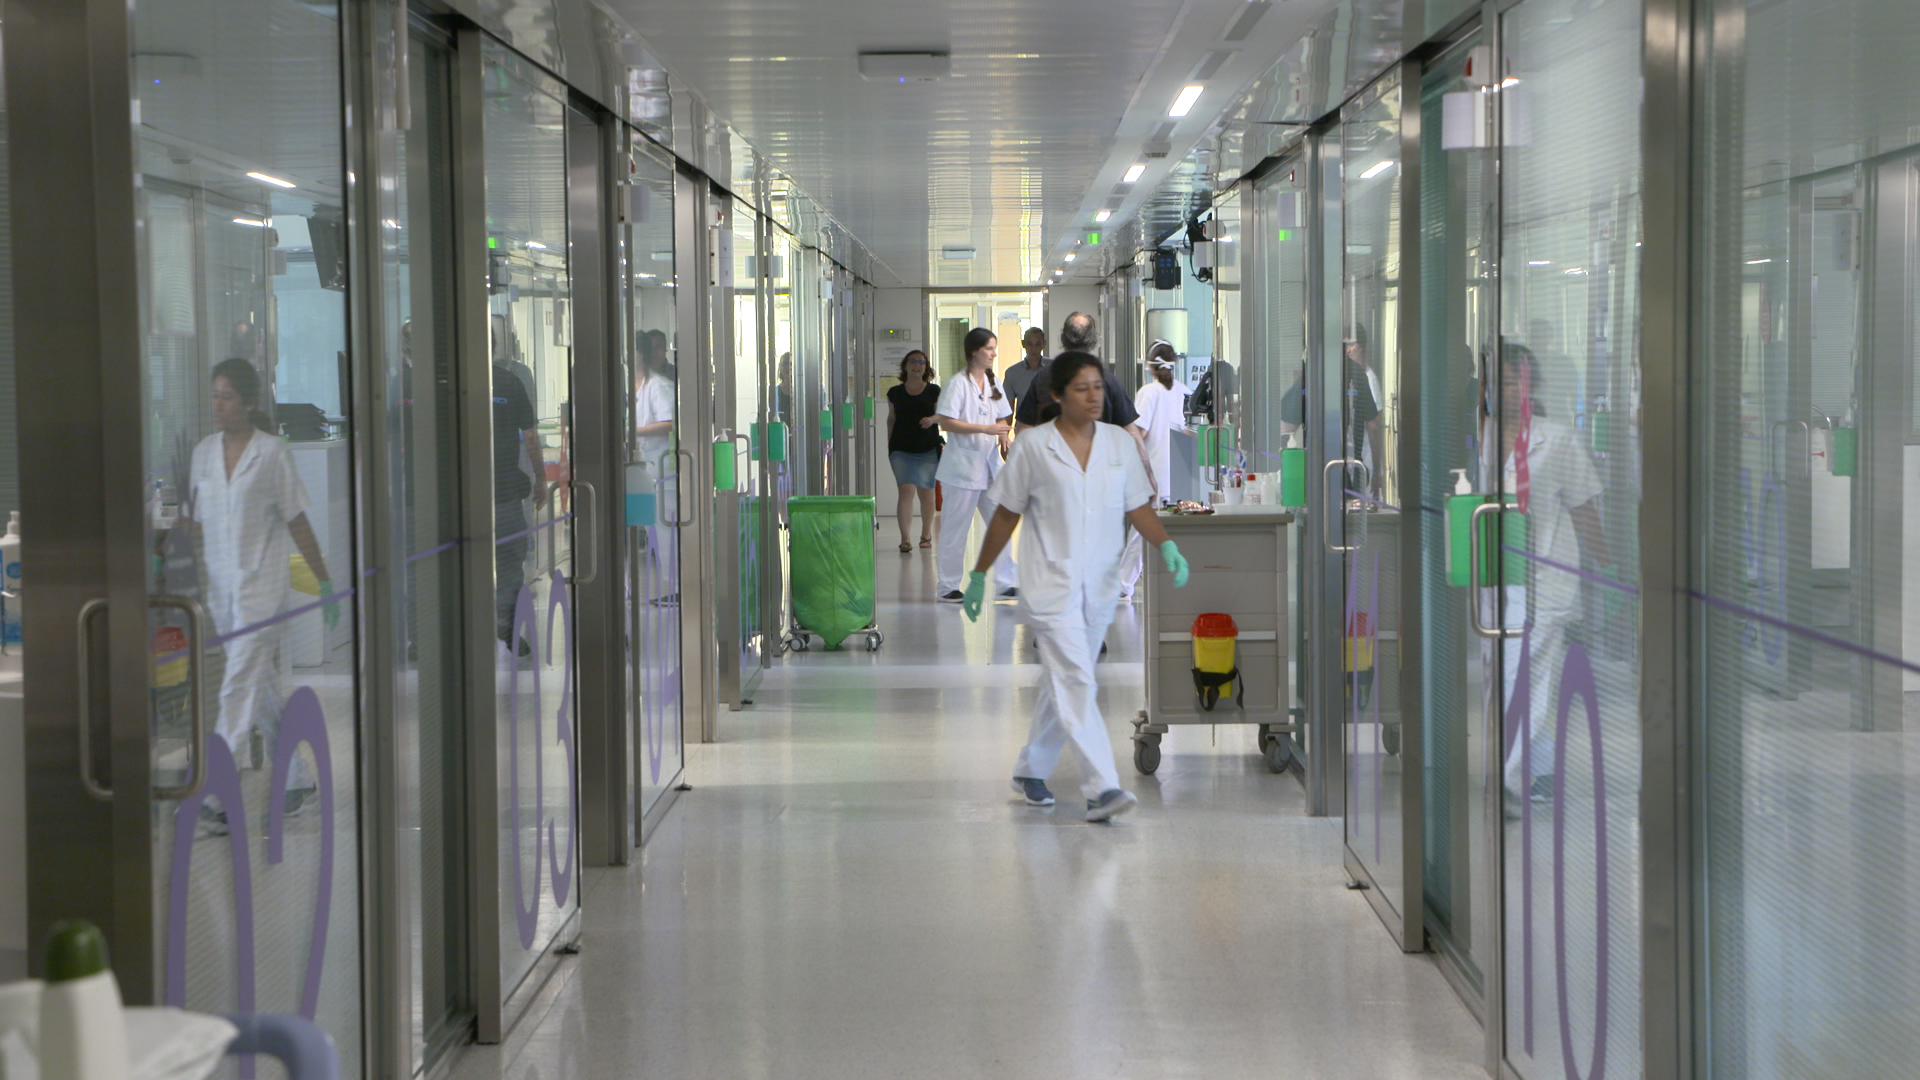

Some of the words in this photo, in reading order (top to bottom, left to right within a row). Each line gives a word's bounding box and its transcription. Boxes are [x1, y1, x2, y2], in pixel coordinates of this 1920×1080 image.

[645, 511, 680, 786] 04
[737, 478, 759, 676] 05
[510, 568, 575, 951] 03
[1505, 619, 1608, 1080] 10
